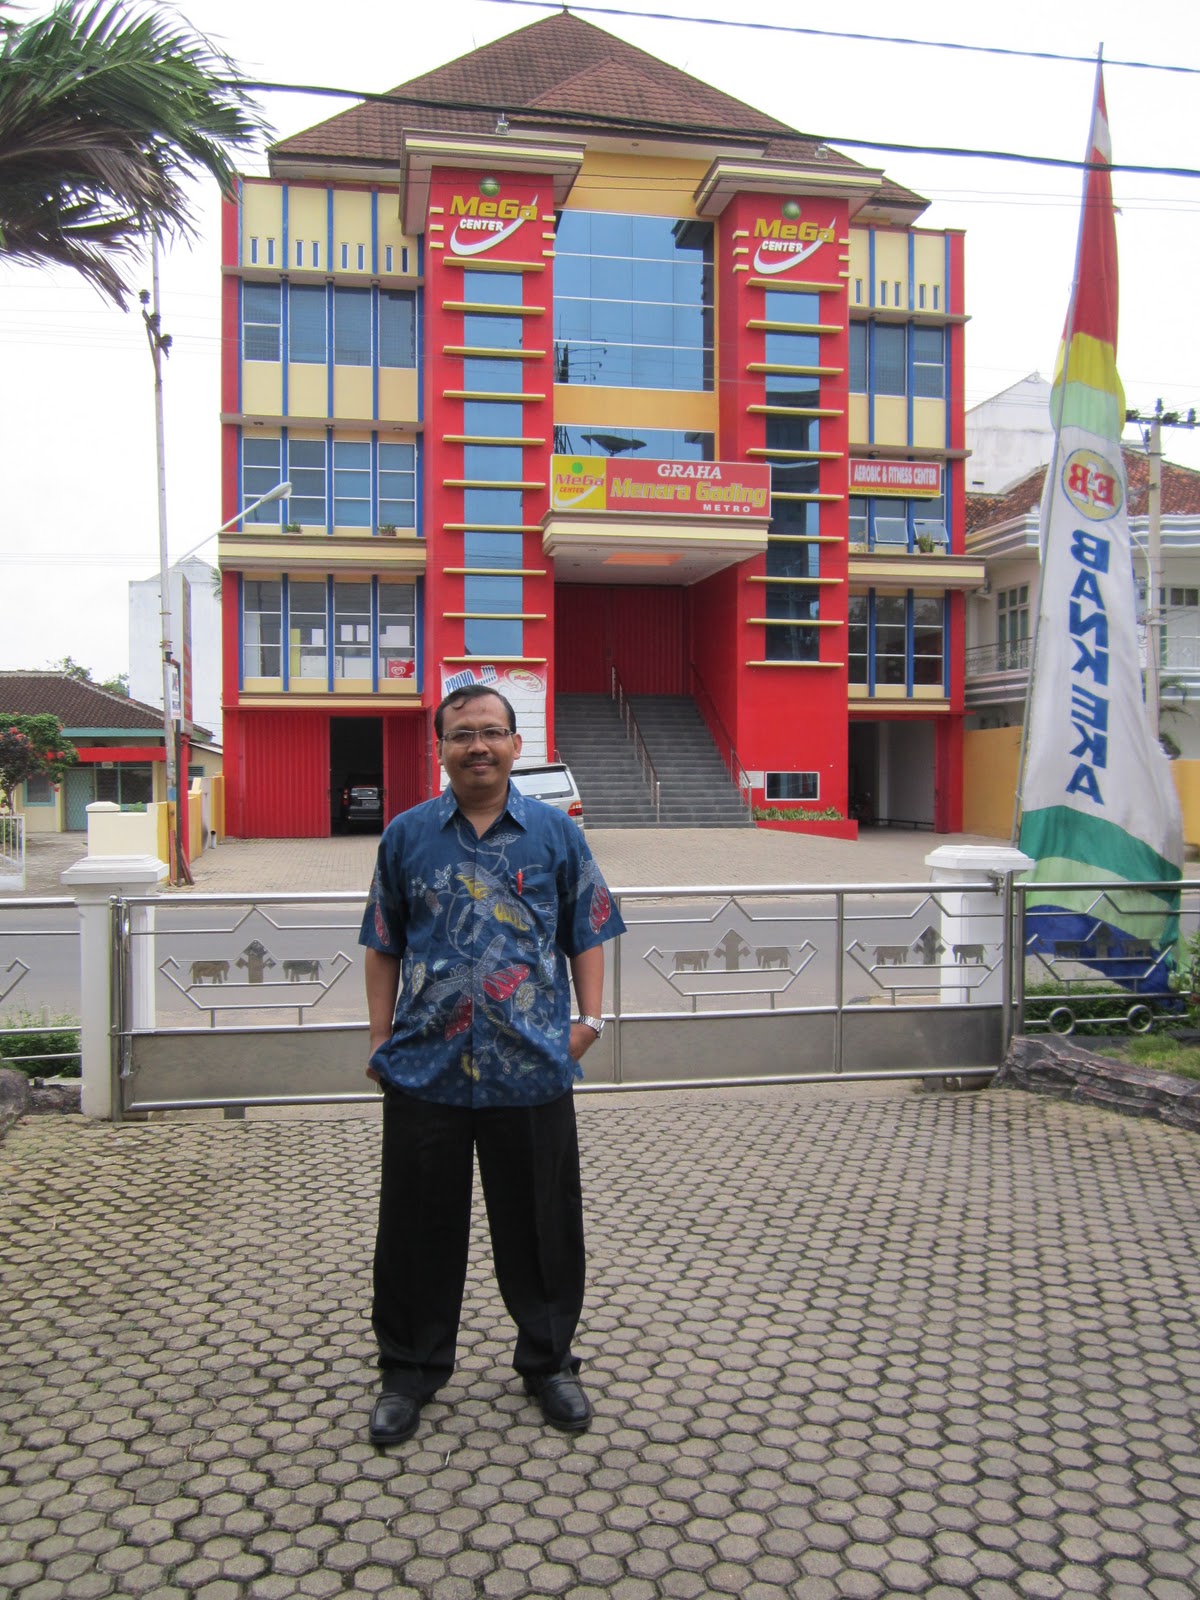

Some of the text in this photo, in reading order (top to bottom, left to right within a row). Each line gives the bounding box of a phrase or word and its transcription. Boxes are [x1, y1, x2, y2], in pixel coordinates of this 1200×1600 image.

[450, 195, 538, 220] MeGa
[460, 219, 504, 232] CENTER
[754, 218, 835, 242] MeGa
[762, 240, 803, 253] CENTER
[657, 463, 722, 479] GRAHA
[854, 464, 936, 485] AEROBIC & FITNESS CENTER
[556, 473, 604, 486] MeGa
[610, 477, 767, 508] Menara Gading
[703, 503, 750, 513] METRO
